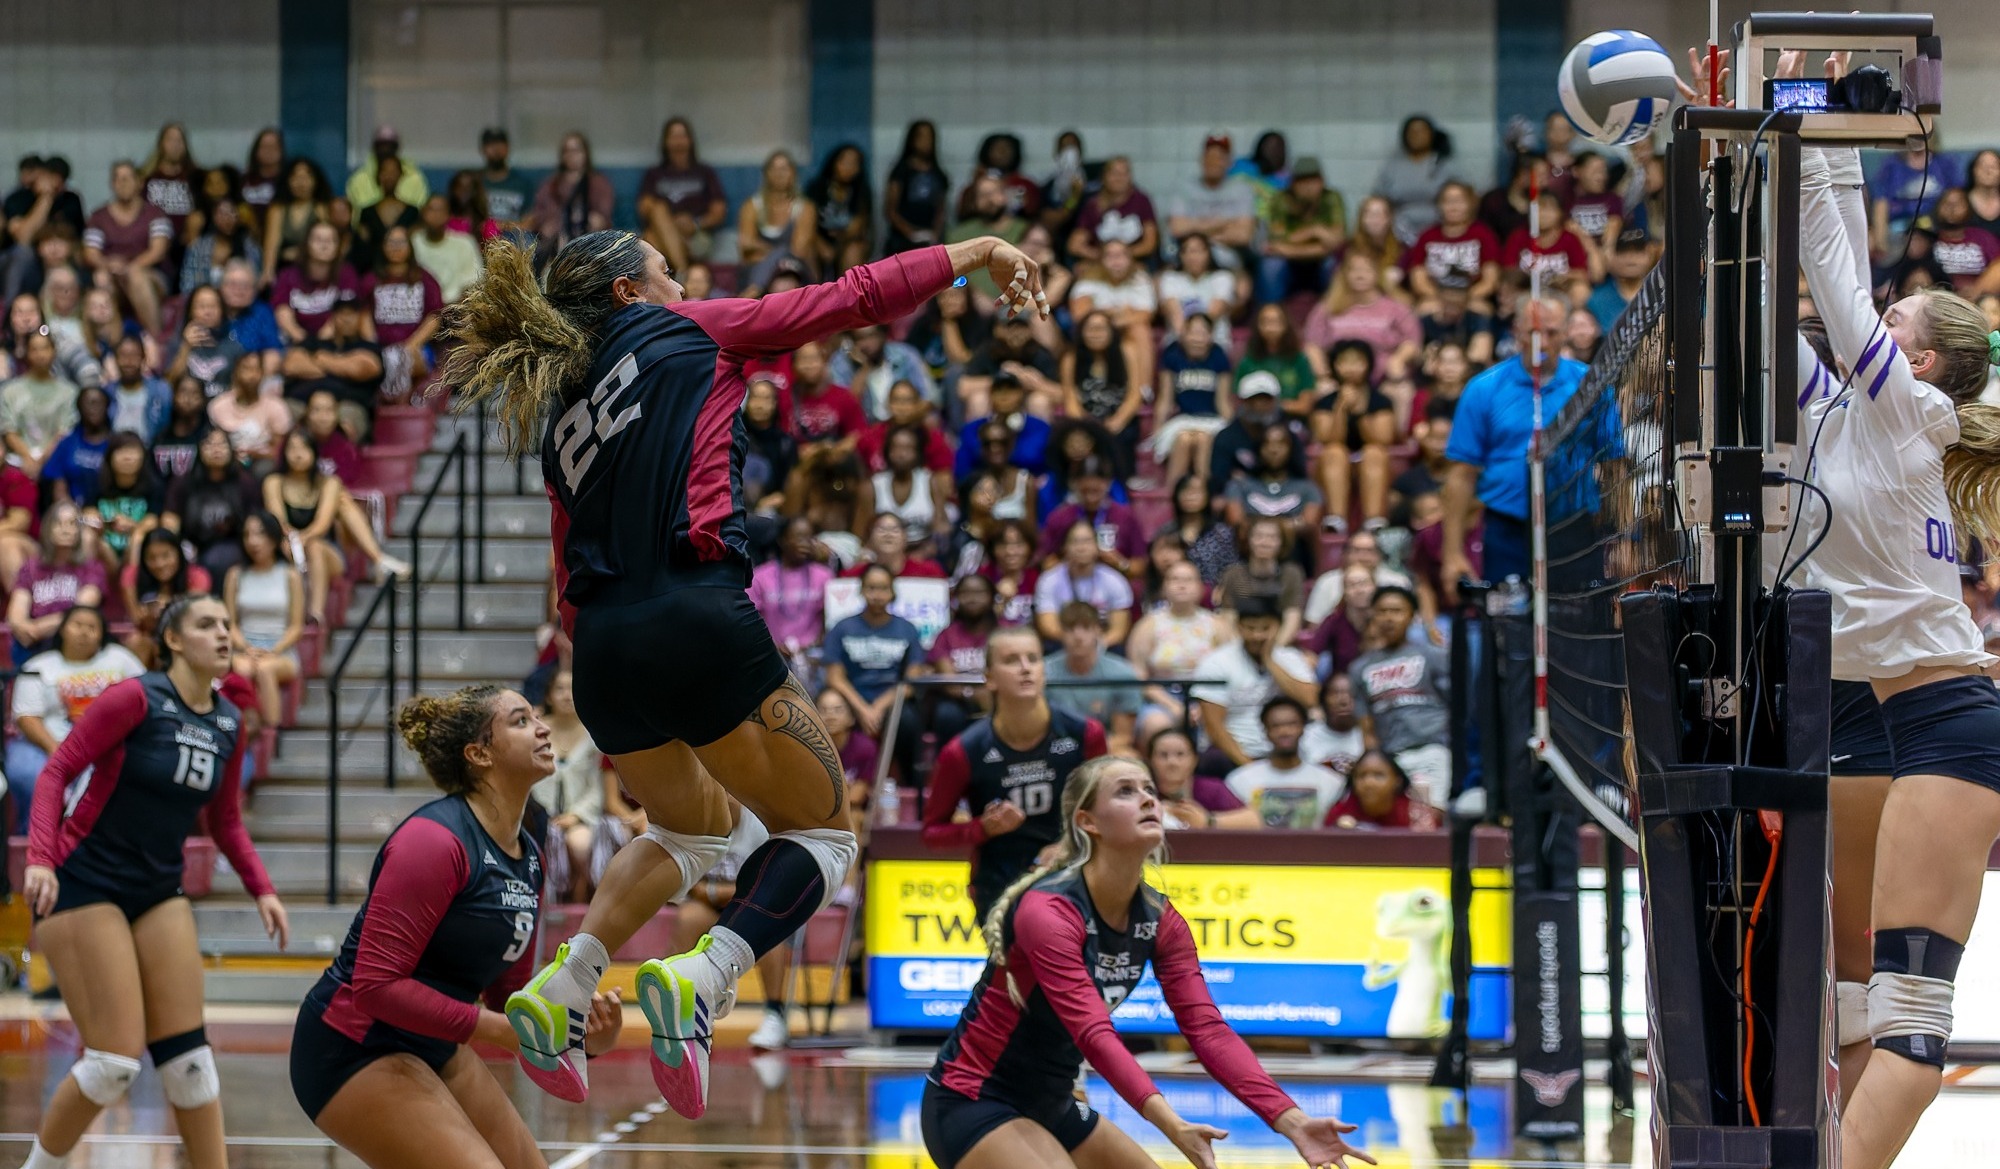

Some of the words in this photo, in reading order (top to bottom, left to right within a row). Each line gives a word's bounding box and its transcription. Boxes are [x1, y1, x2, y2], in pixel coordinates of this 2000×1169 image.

[554, 353, 642, 495] 22
[173, 745, 215, 791] 19
[1007, 782, 1053, 816] 10
[502, 912, 534, 962] 9
[903, 914, 980, 943] TW
[1189, 917, 1296, 948] TICS
